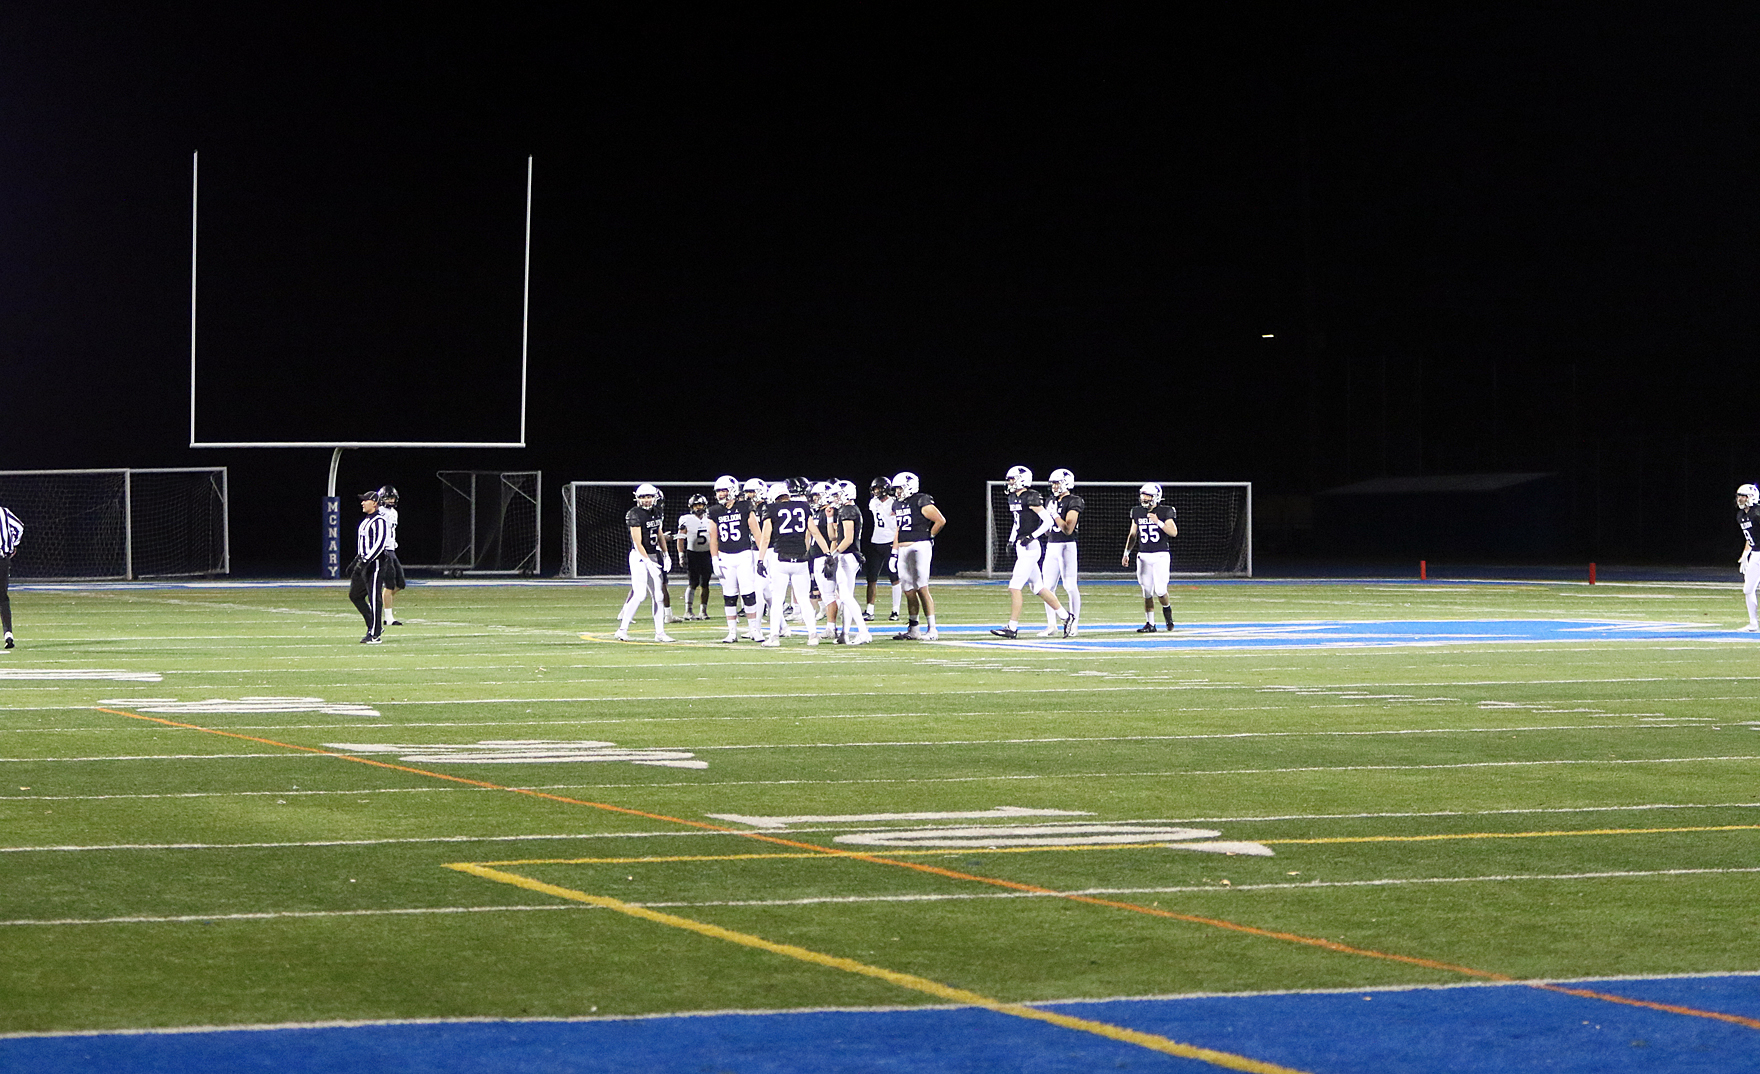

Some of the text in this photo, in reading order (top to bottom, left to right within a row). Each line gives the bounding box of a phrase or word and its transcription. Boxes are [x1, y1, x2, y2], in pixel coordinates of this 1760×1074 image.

[718, 513, 741, 523] SHELDON
[777, 507, 806, 534] 23
[896, 516, 912, 531] 72
[327, 501, 338, 577] MCNARY
[649, 527, 658, 546] 5
[697, 529, 707, 545] 5
[718, 521, 741, 542] 65
[1138, 524, 1160, 544] 55
[704, 805, 1222, 847] 10
